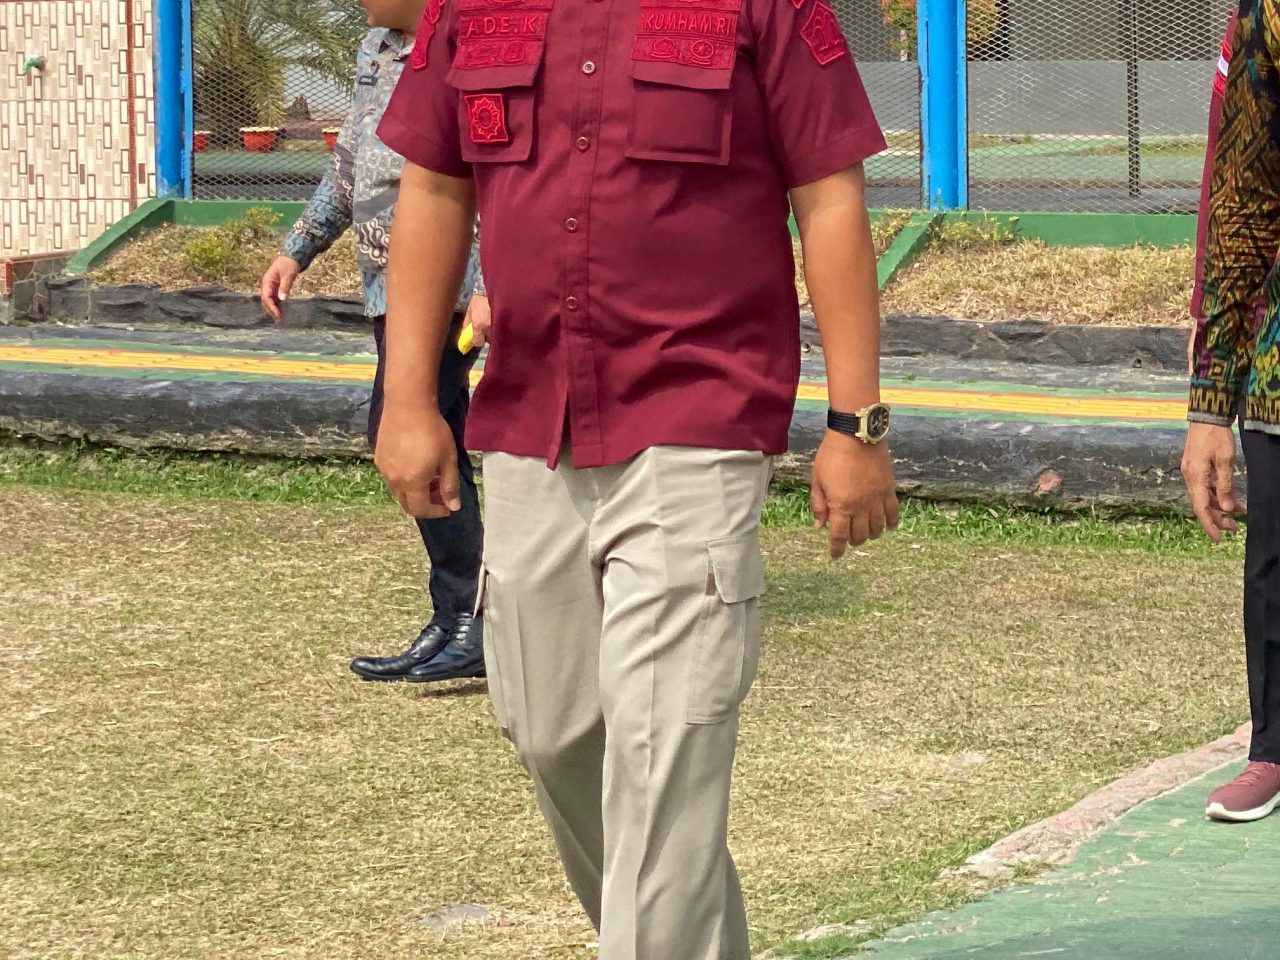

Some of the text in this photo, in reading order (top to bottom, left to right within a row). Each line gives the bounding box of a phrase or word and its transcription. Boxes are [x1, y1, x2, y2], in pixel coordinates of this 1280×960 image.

[465, 16, 538, 38] ADE.K
[644, 12, 732, 36] KUMHAM RI
